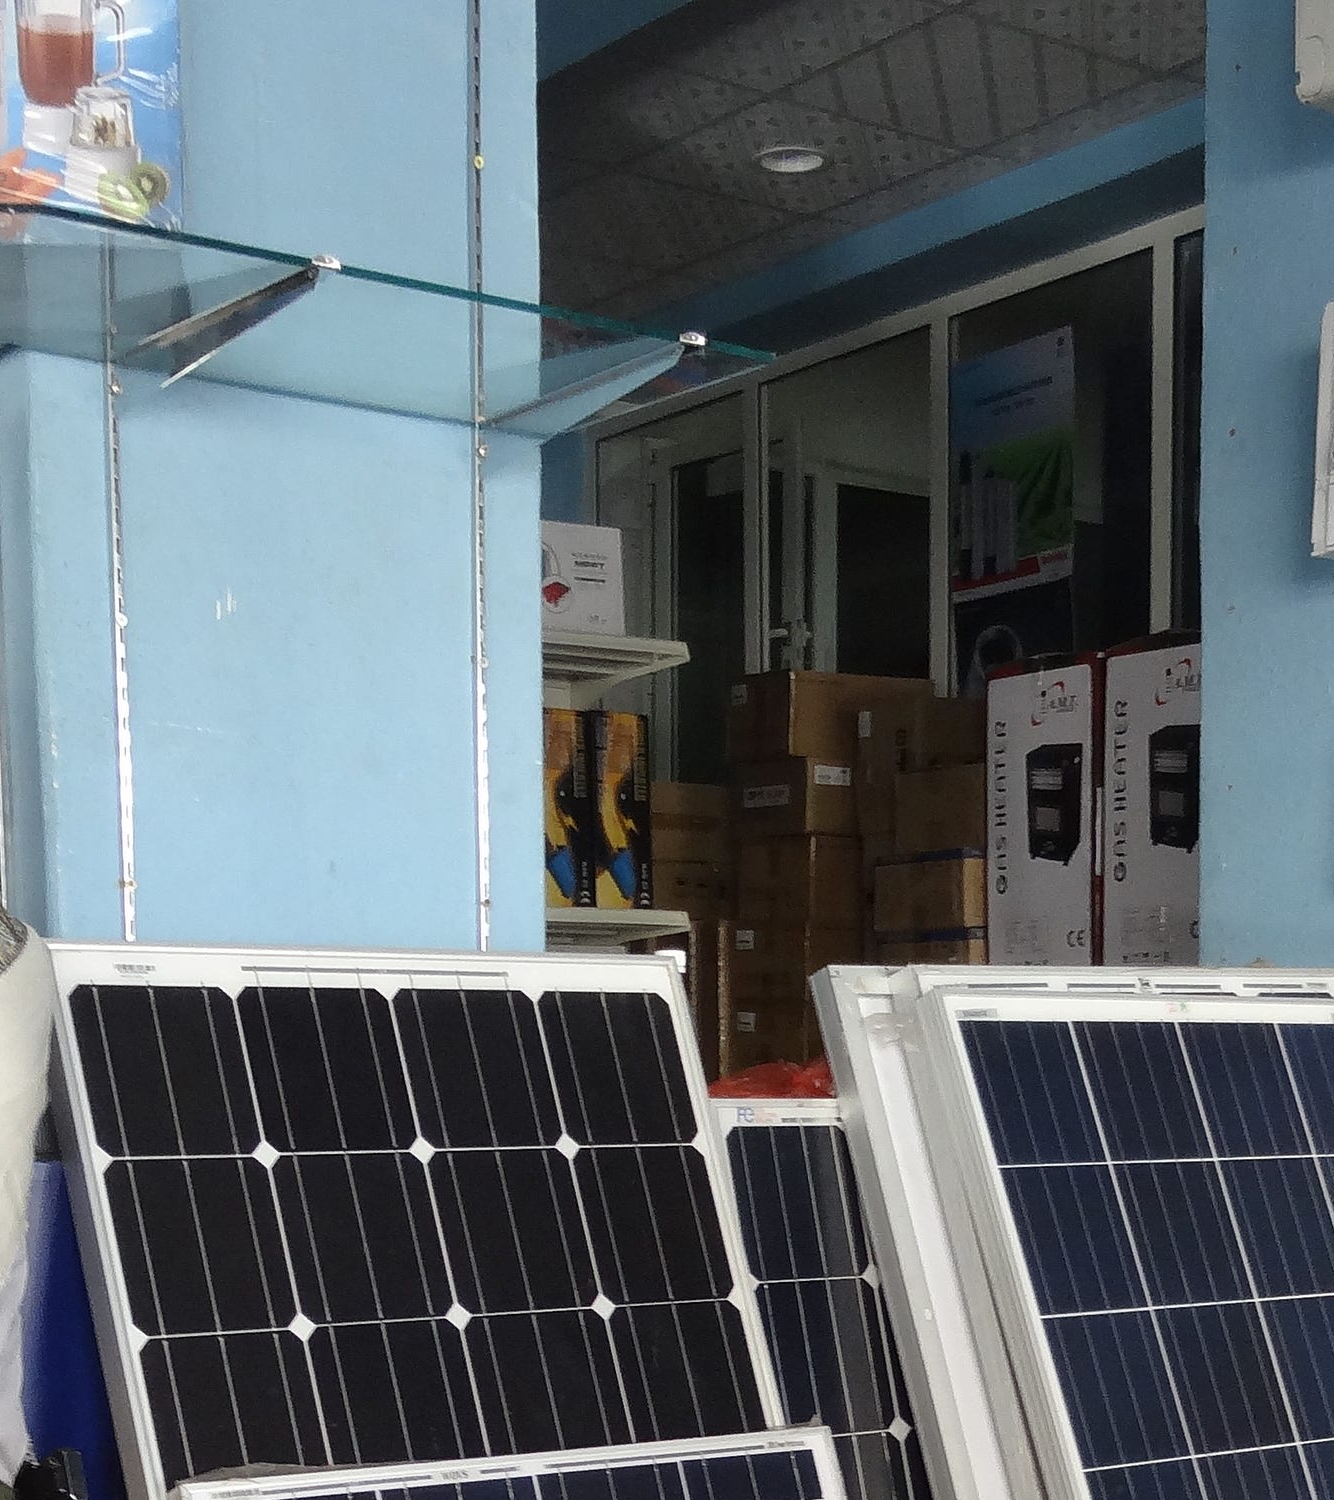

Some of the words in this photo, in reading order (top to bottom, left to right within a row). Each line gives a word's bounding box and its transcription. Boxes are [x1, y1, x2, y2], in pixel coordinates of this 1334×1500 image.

[994, 720, 1008, 827] HEATER
[1113, 699, 1128, 812] HEATER
[994, 835, 1008, 895] GAS
[1113, 820, 1128, 882] GAS
[1067, 930, 1086, 948] CE
